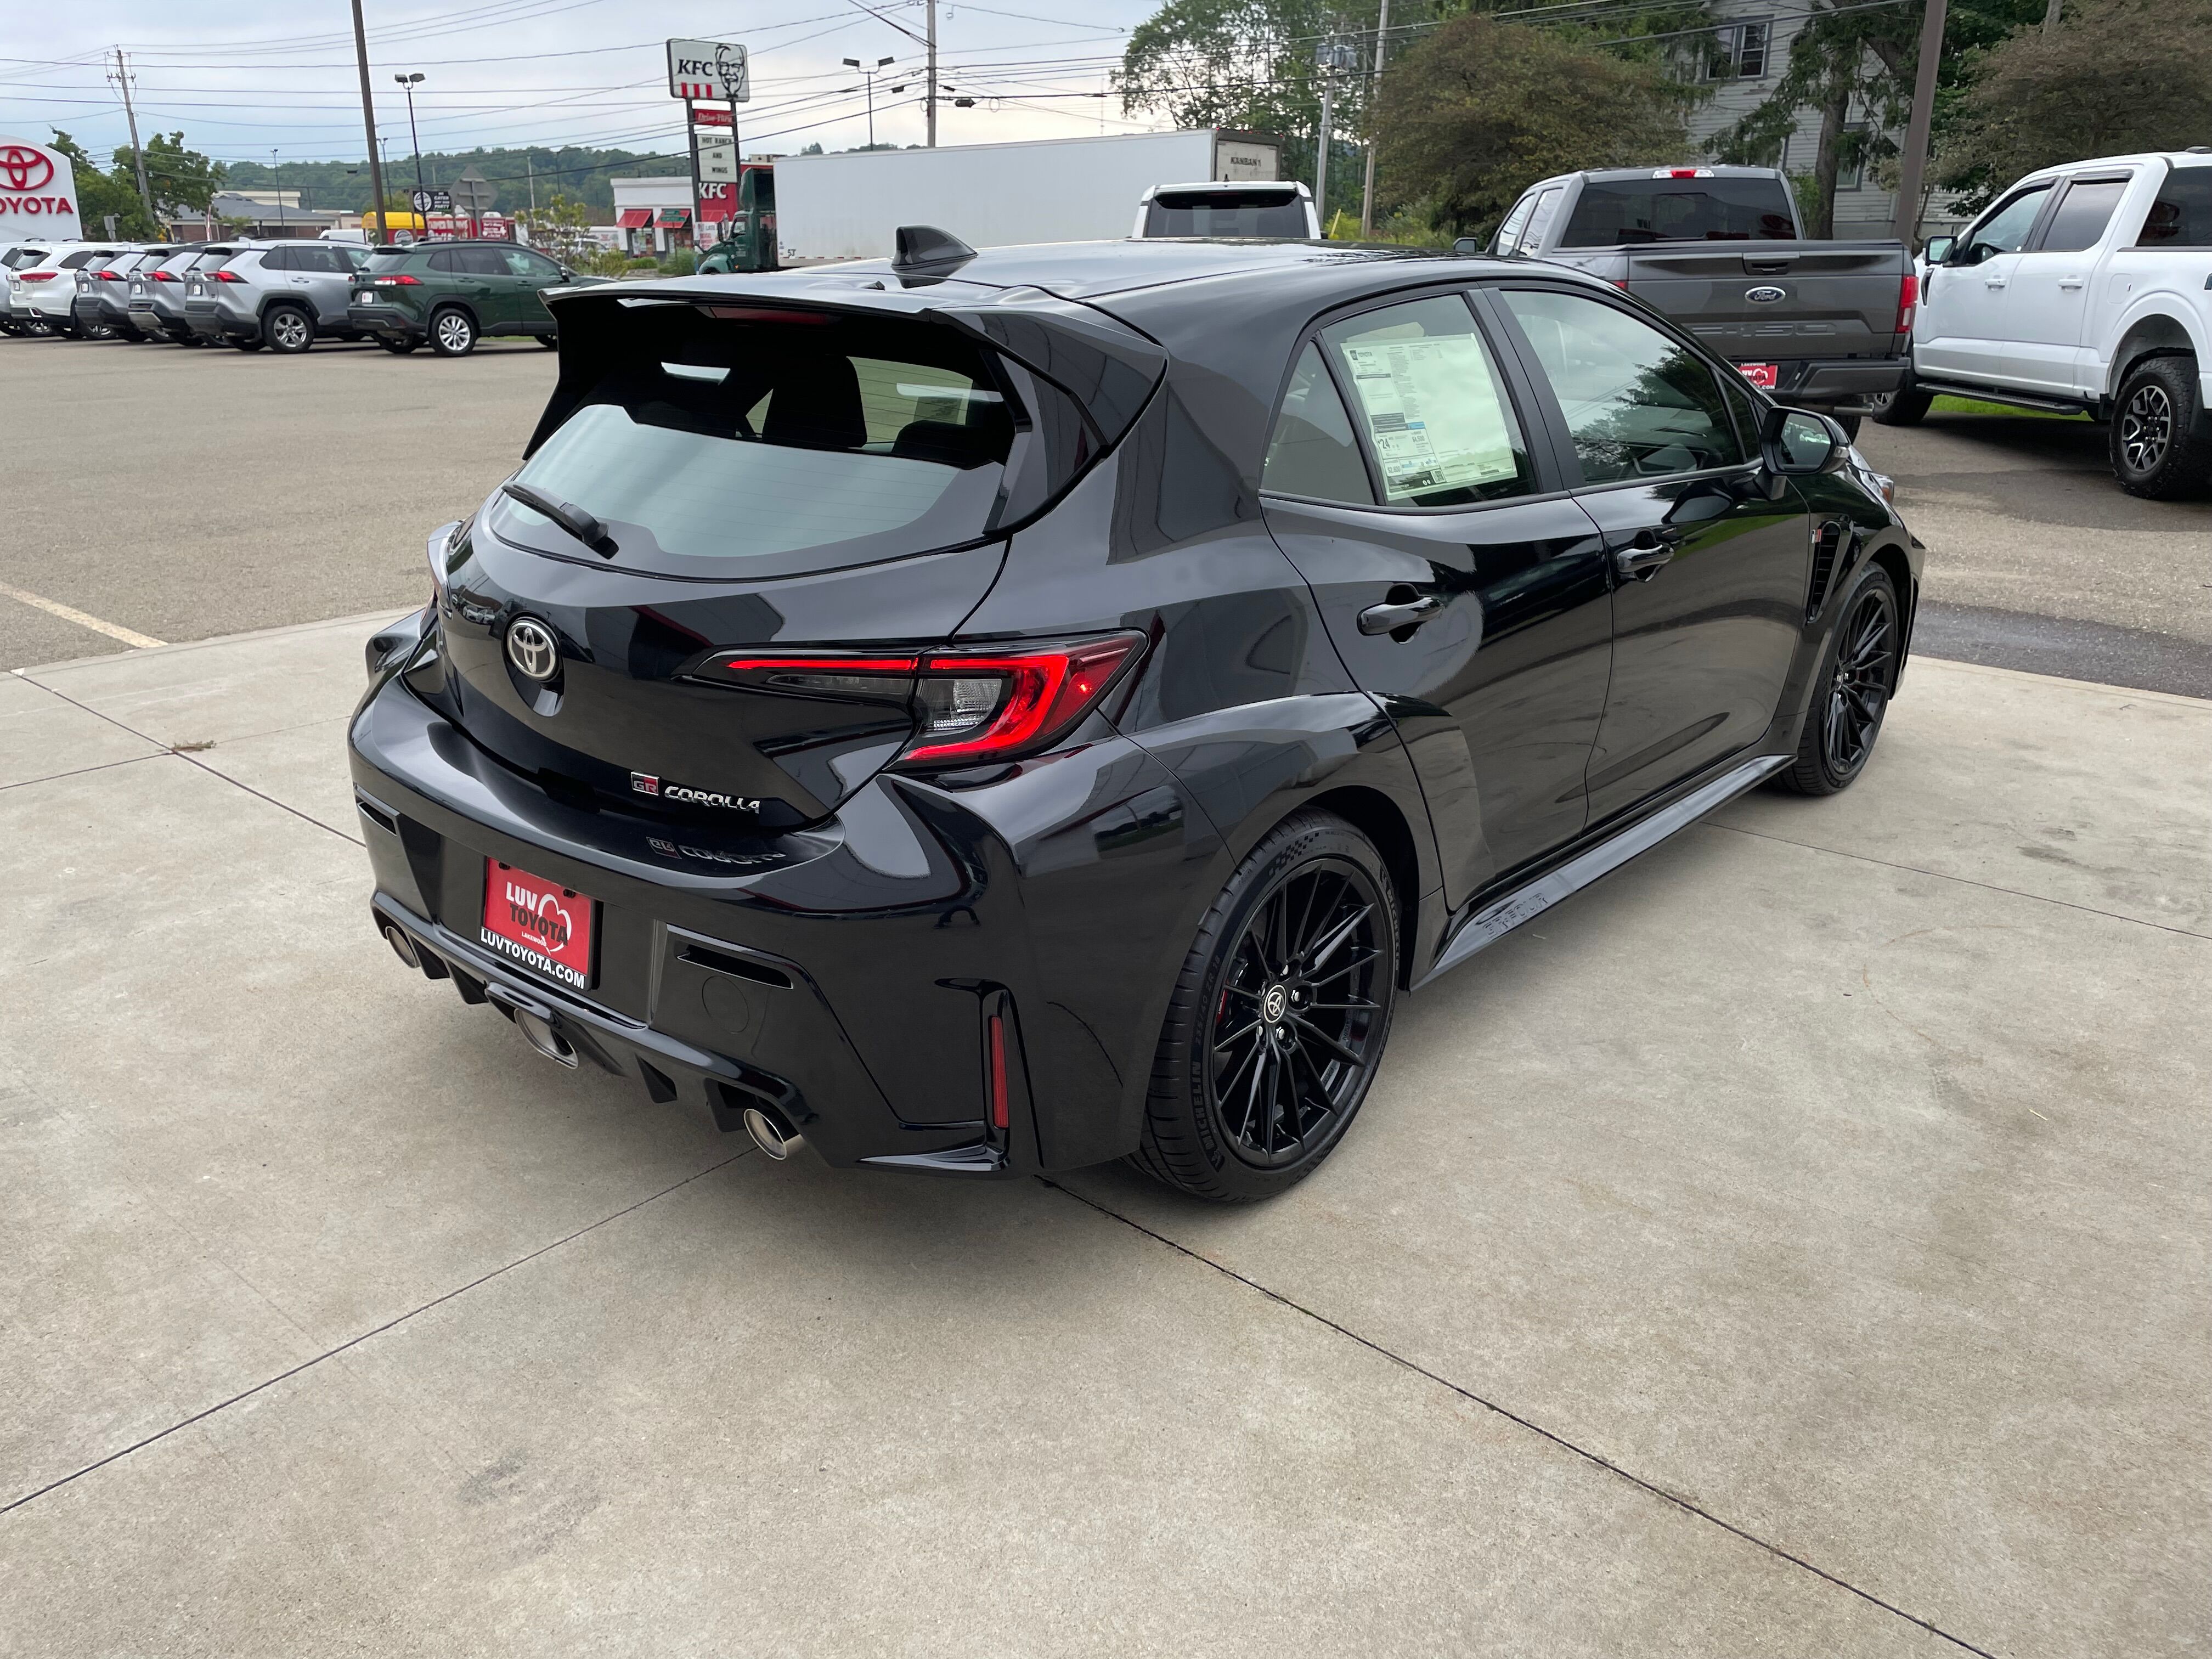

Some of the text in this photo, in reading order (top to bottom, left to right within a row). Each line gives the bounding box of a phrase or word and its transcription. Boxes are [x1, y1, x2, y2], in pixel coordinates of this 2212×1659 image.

[678, 59, 713, 76] KFC
[698, 182, 727, 199] KFC
[0, 197, 74, 214] YOTA
[1754, 290, 1777, 301] Ford
[634, 780, 760, 814] GR COROLLA
[506, 881, 538, 911] LUV
[510, 902, 568, 946] TOYOTA
[521, 931, 547, 947] LAKEWOOD
[481, 928, 585, 989] LUVTOYOTA.COM
[1192, 1060, 1216, 1150] MICHELIN
